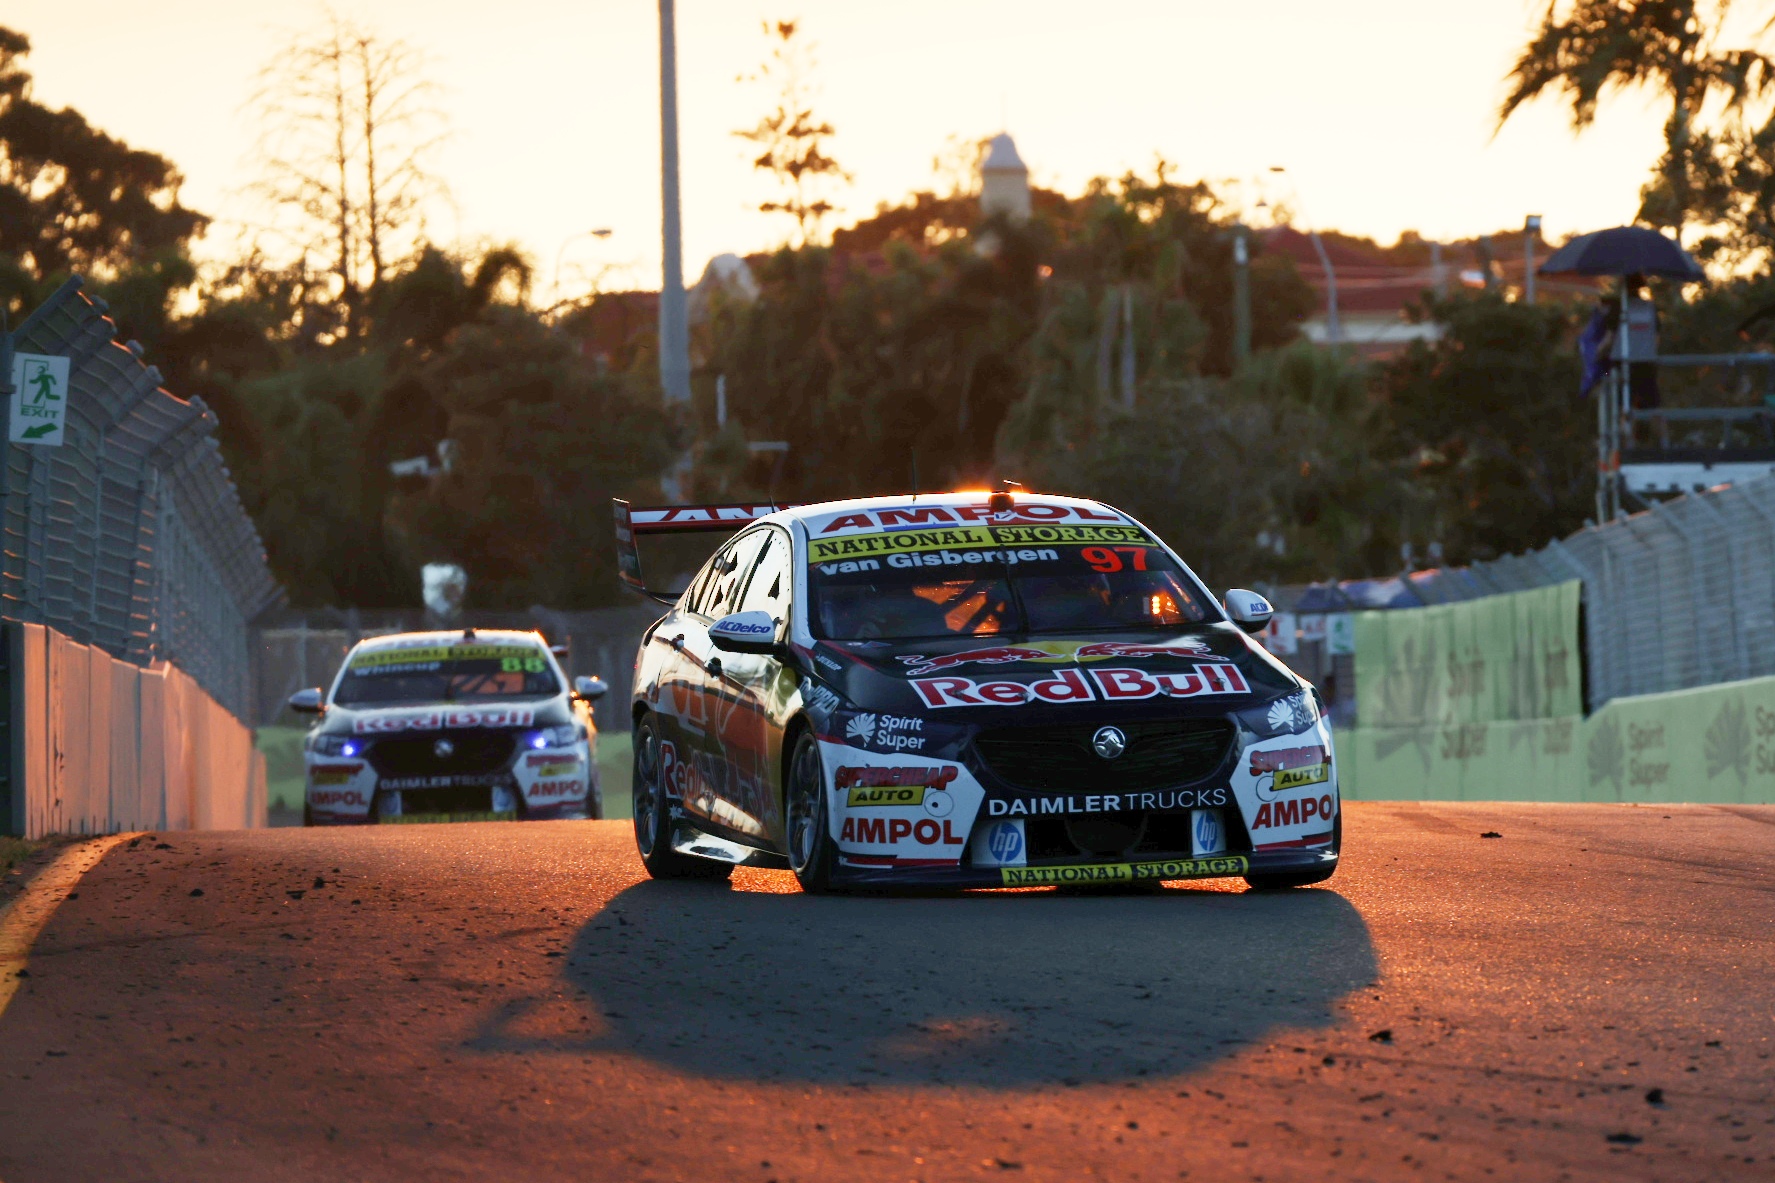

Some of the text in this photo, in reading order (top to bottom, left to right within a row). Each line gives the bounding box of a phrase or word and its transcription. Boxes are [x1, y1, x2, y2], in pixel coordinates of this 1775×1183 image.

[20, 408, 60, 418] EXIT
[821, 502, 1118, 534] AMPOL
[816, 526, 1146, 557] NATIONAL STORAGE
[819, 549, 1059, 576] van Gisbergen
[1081, 546, 1149, 572] 97
[716, 621, 771, 634] ACDelco
[501, 657, 546, 674] 88
[910, 664, 1249, 708] Red Bull
[879, 714, 923, 731] Spirit
[876, 731, 926, 750] Super
[1280, 768, 1323, 785] AUTO
[855, 789, 914, 802] AUTO
[989, 788, 1227, 816] DAIMLER TRUCKS
[1251, 794, 1334, 830] AMPO
[840, 817, 964, 845] AMPOL
[992, 823, 1019, 862] hp
[1199, 811, 1217, 851] hp
[1006, 858, 1240, 884] NATIONAL STORAGE
